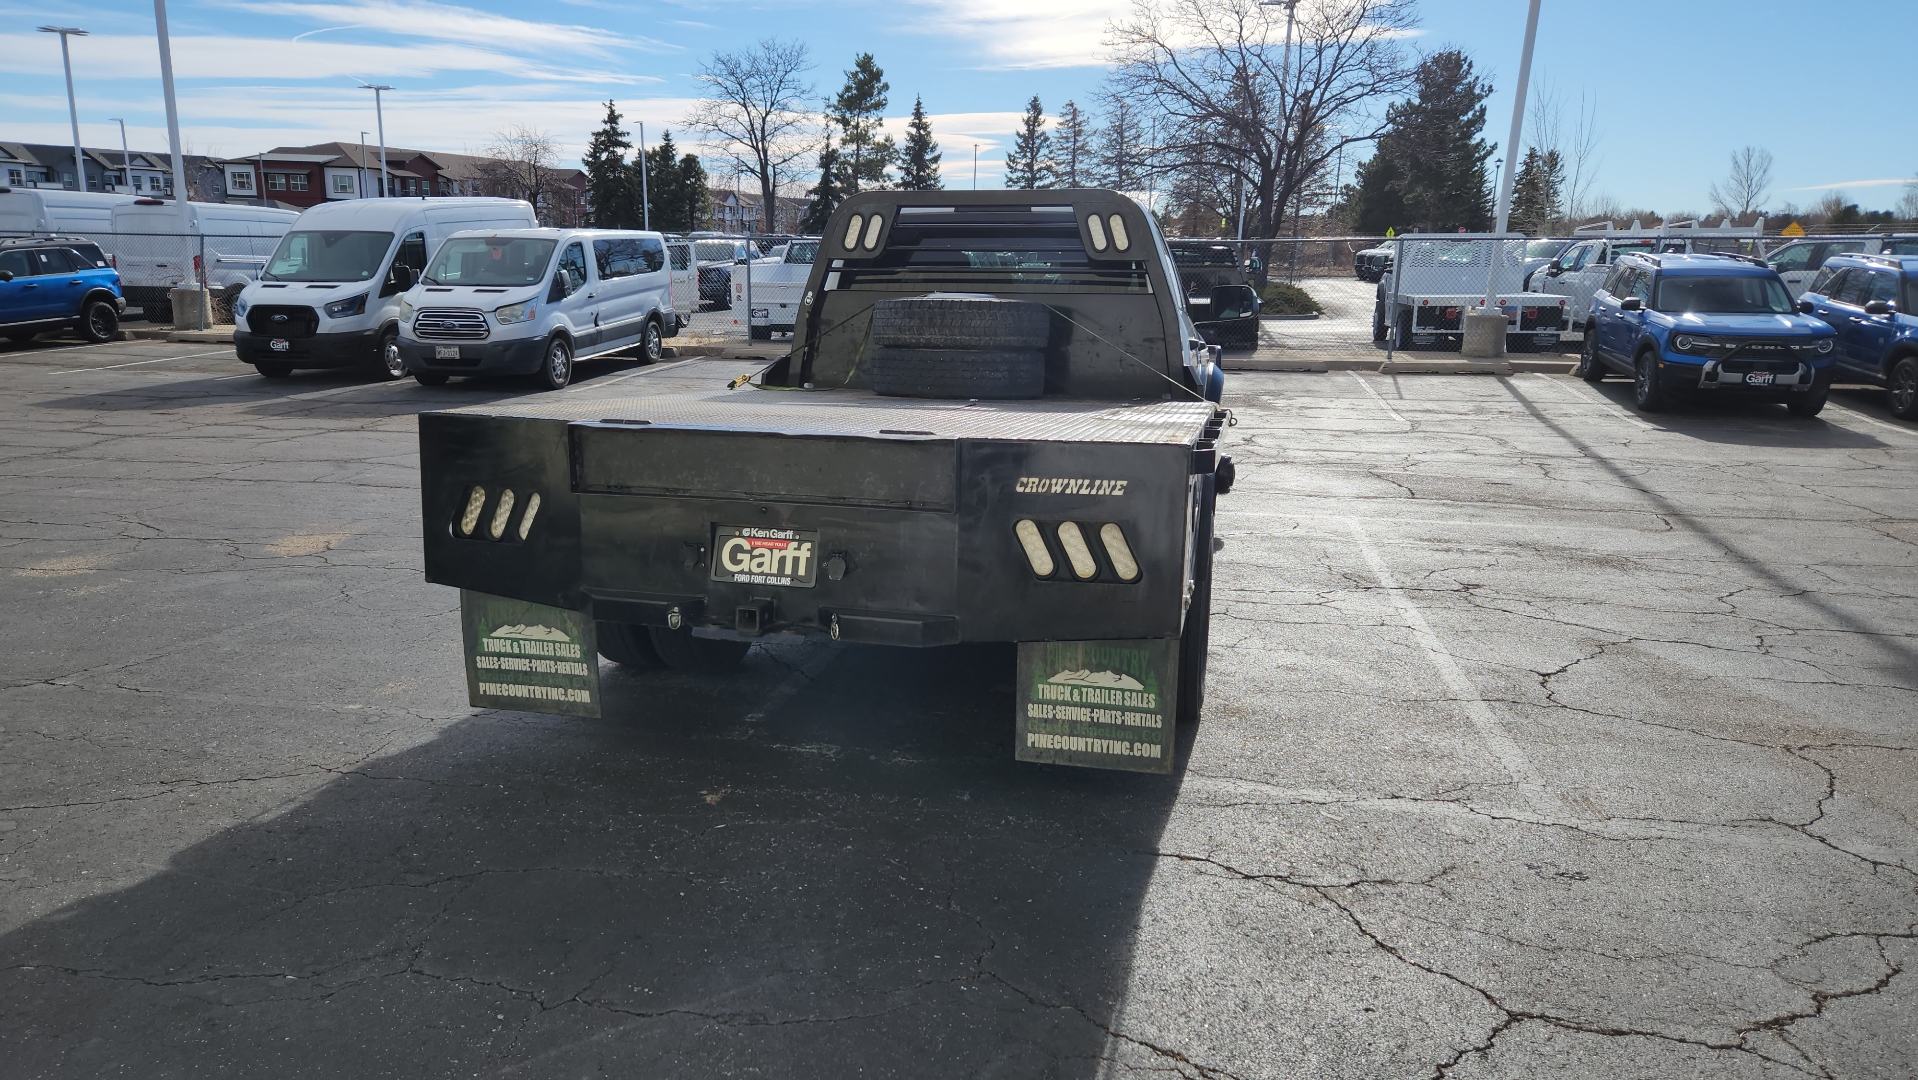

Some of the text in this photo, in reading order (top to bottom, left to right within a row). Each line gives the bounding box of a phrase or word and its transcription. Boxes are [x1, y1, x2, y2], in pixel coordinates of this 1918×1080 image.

[1745, 373, 1774, 384] Garff
[1015, 477, 1128, 496] CROWNLINE
[751, 528, 794, 540] Ken Garff
[721, 537, 812, 576] Garff
[734, 573, 750, 583] FORD
[751, 574, 767, 584] FORT
[482, 638, 581, 659] TRUCK & TRAILER SALES
[1083, 645, 1150, 682] COUNTRY
[479, 682, 591, 703] PINECOUNTRYINC.COM
[1037, 683, 1156, 709] TRUCK & TRAILER SALES
[1027, 733, 1162, 759] PINECOUNTRYINC.COM
[1141, 730, 1162, 742] CO
